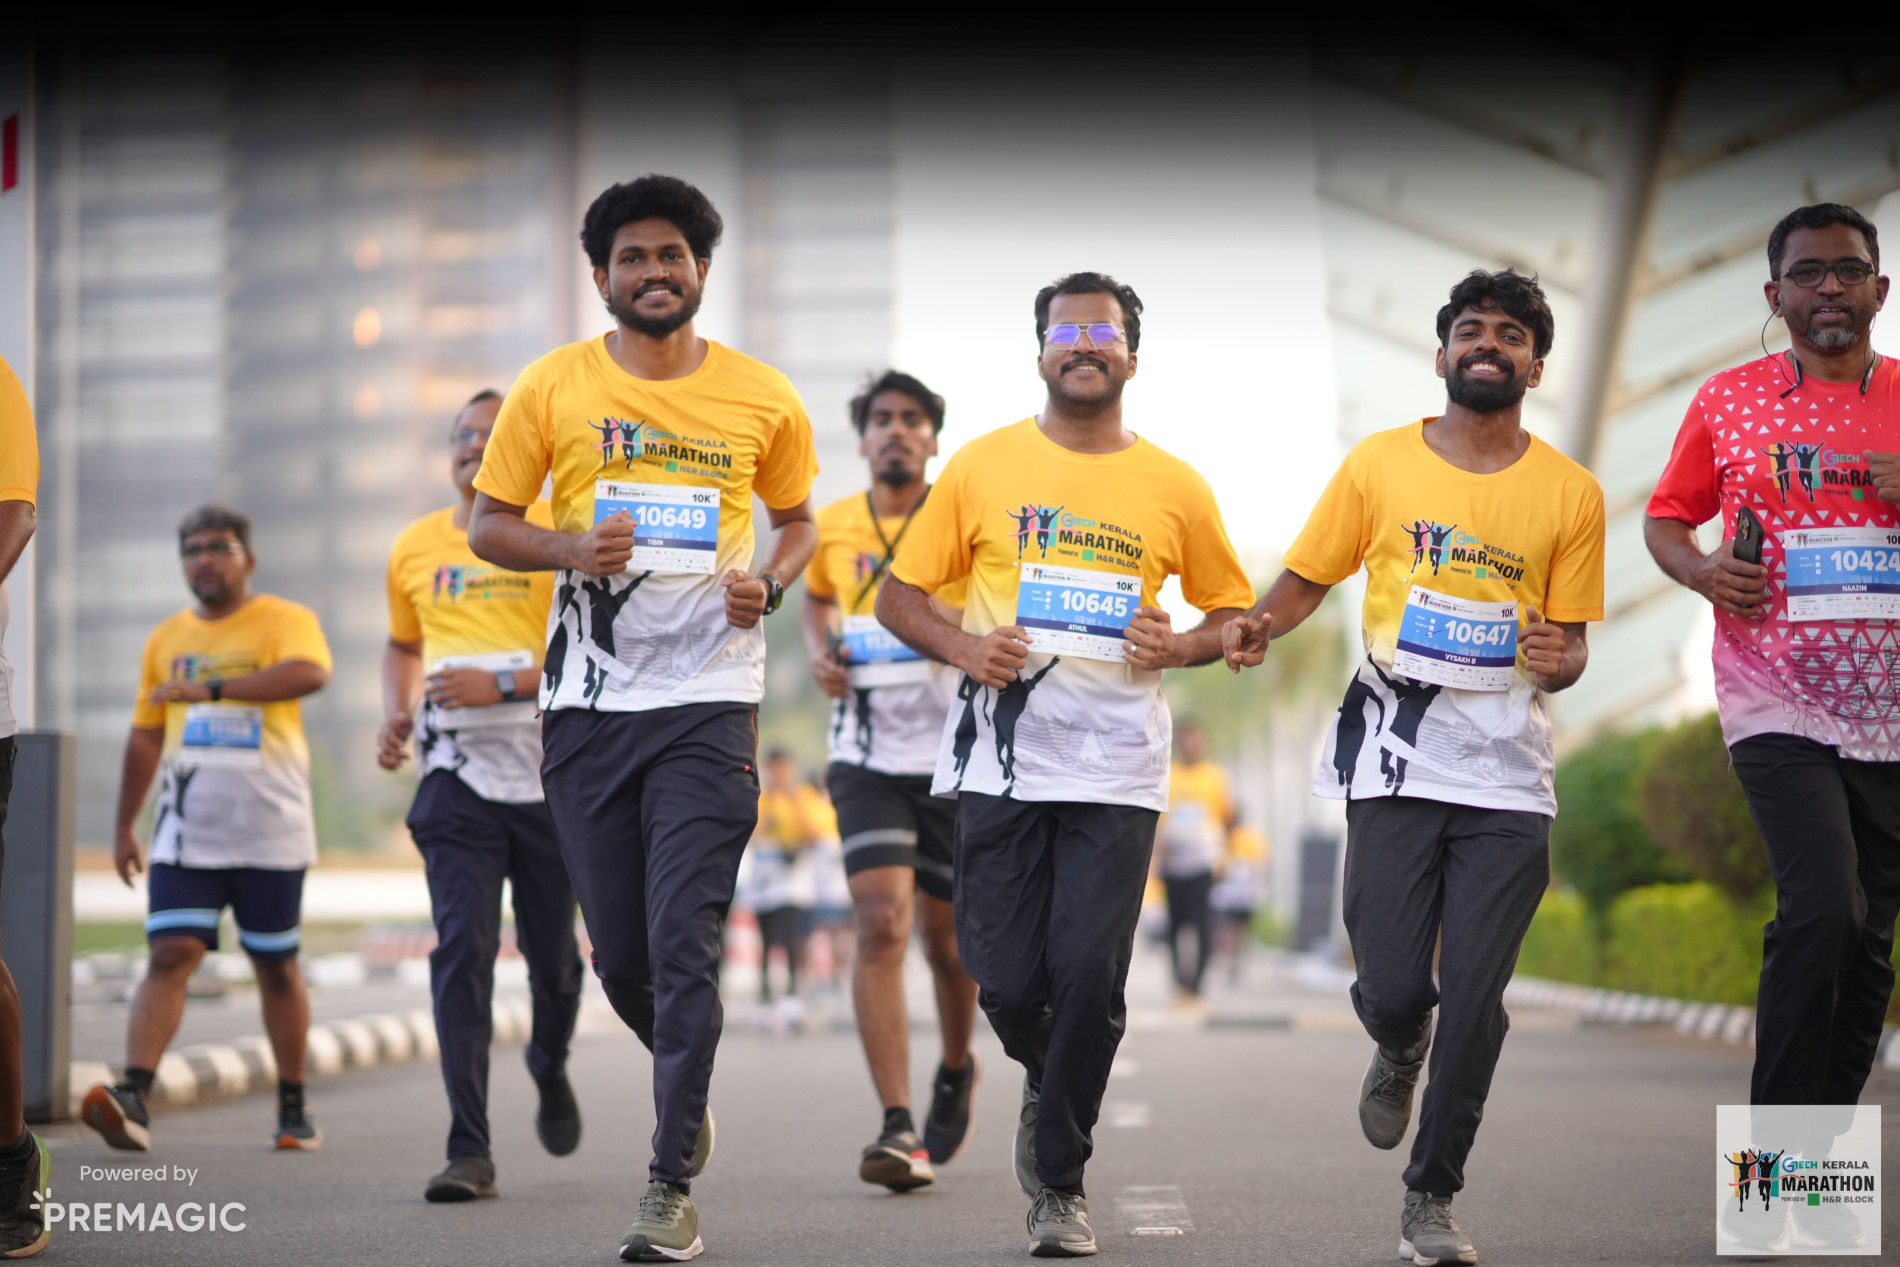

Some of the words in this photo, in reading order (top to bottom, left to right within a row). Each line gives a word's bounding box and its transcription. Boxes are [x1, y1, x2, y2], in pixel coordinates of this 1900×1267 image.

[682, 435, 727, 448] KERALA
[644, 443, 732, 468] MARATHON
[680, 465, 698, 475] H&R
[700, 468, 728, 480] BLOCK
[692, 493, 711, 503] 10K
[636, 505, 706, 529] 10649
[1100, 522, 1142, 542] KERALA
[1886, 535, 1900, 544] 10
[1058, 530, 1143, 560] MARATHON
[1096, 554, 1114, 564] H&R
[1483, 543, 1524, 564] KERALA
[1830, 550, 1900, 572] 10424
[1116, 581, 1134, 592] 10K
[1060, 590, 1128, 617] 10645
[1501, 607, 1514, 618] 10K
[1068, 624, 1087, 632] ATHUL
[1445, 620, 1511, 646] 10647
[1445, 653, 1470, 663] VYSAKH
